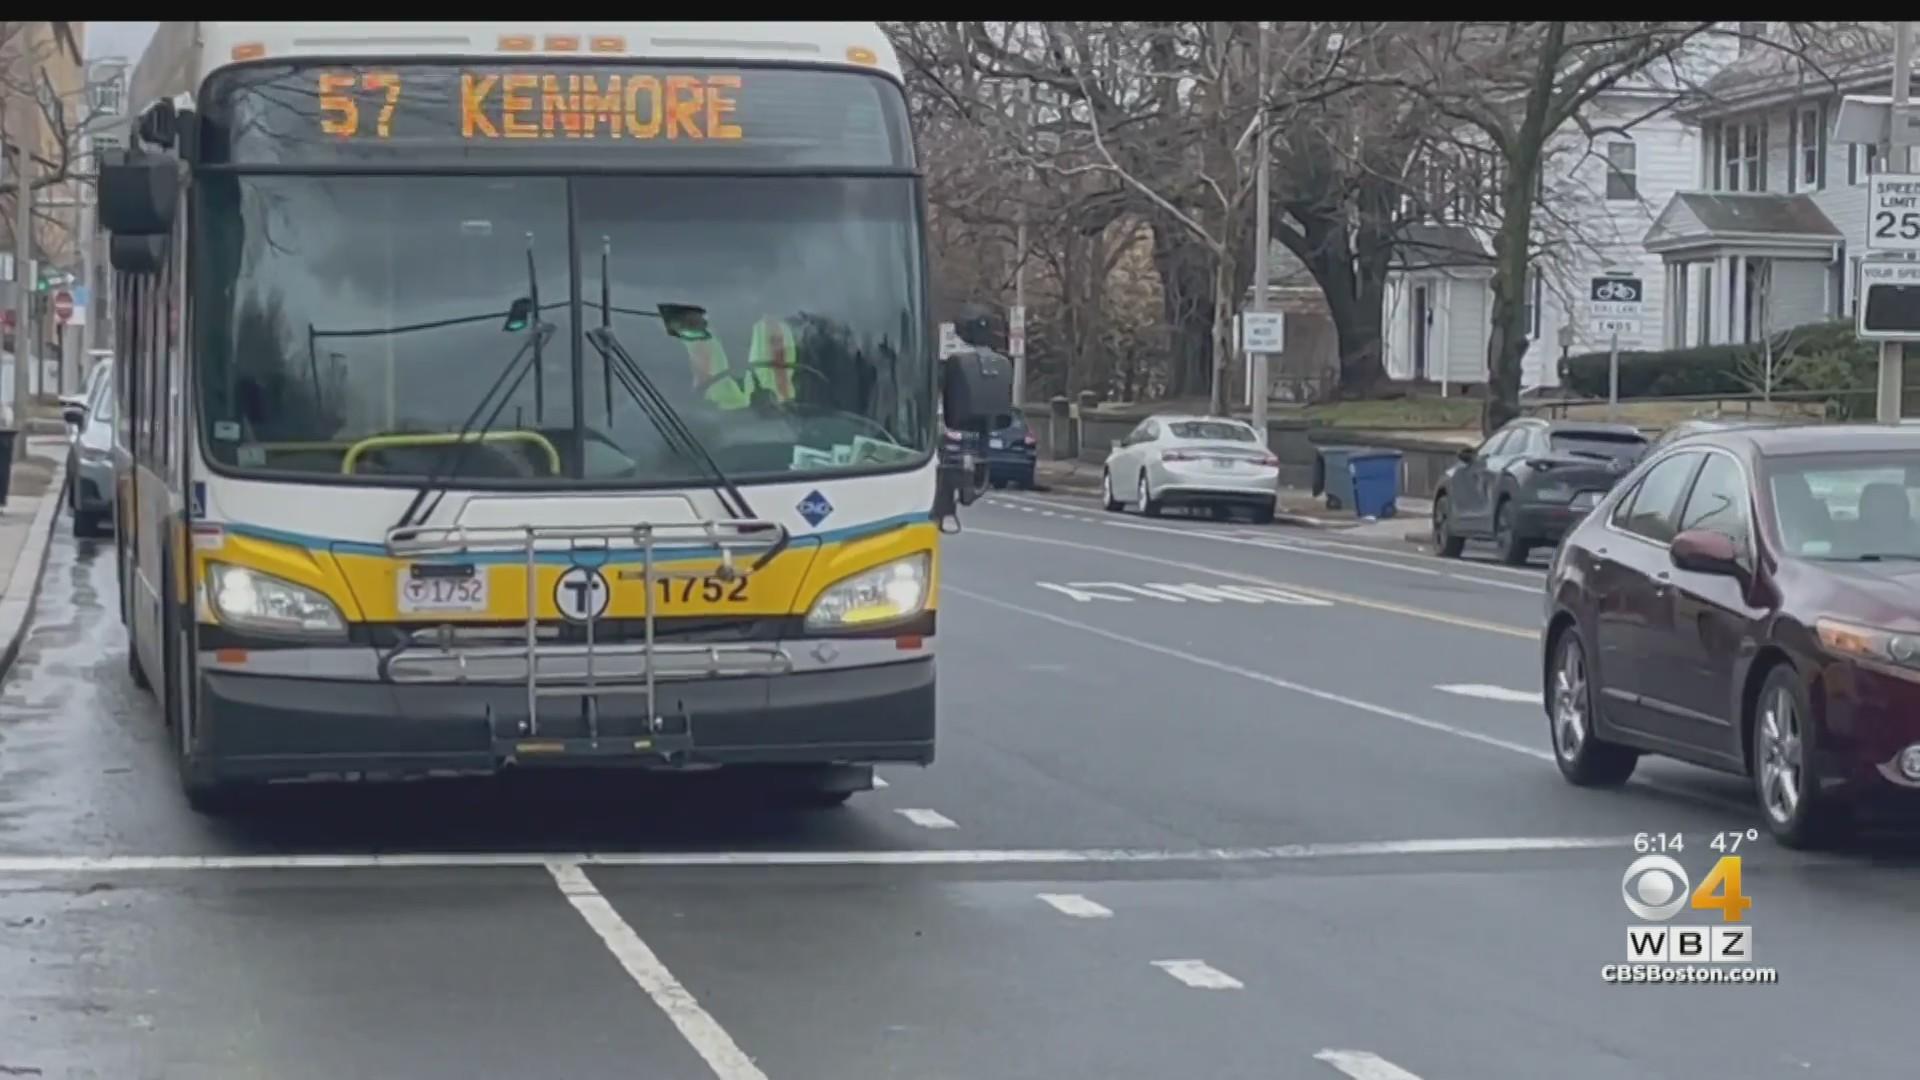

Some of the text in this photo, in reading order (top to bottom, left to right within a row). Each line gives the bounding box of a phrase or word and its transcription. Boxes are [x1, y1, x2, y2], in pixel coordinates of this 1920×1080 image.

[318, 74, 743, 139] 57 KENMORE
[1880, 196, 1916, 208] LIMIT
[1875, 210, 1920, 240] 25
[432, 579, 482, 603] 1752
[657, 575, 749, 604] 1752
